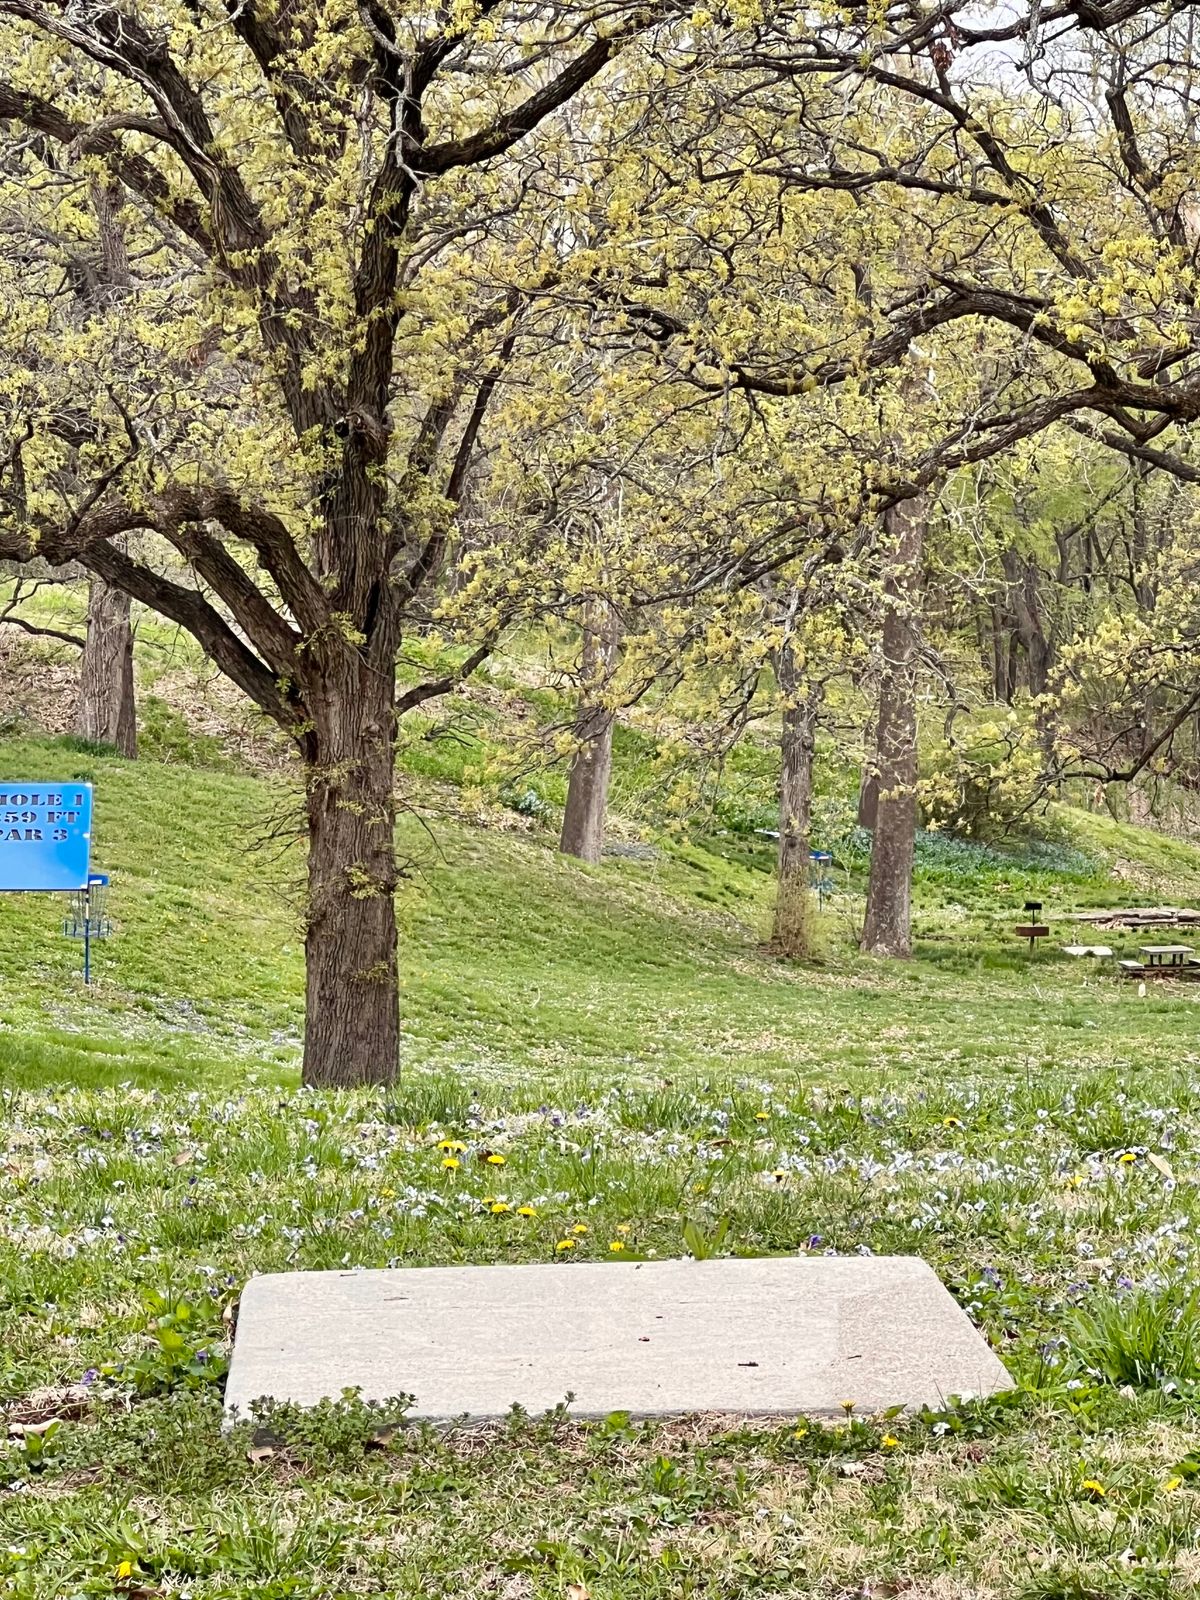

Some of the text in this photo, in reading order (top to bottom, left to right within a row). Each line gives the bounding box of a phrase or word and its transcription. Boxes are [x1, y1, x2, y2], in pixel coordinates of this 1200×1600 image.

[0, 811, 80, 823] 59 FT
[0, 829, 67, 841] AR 3
